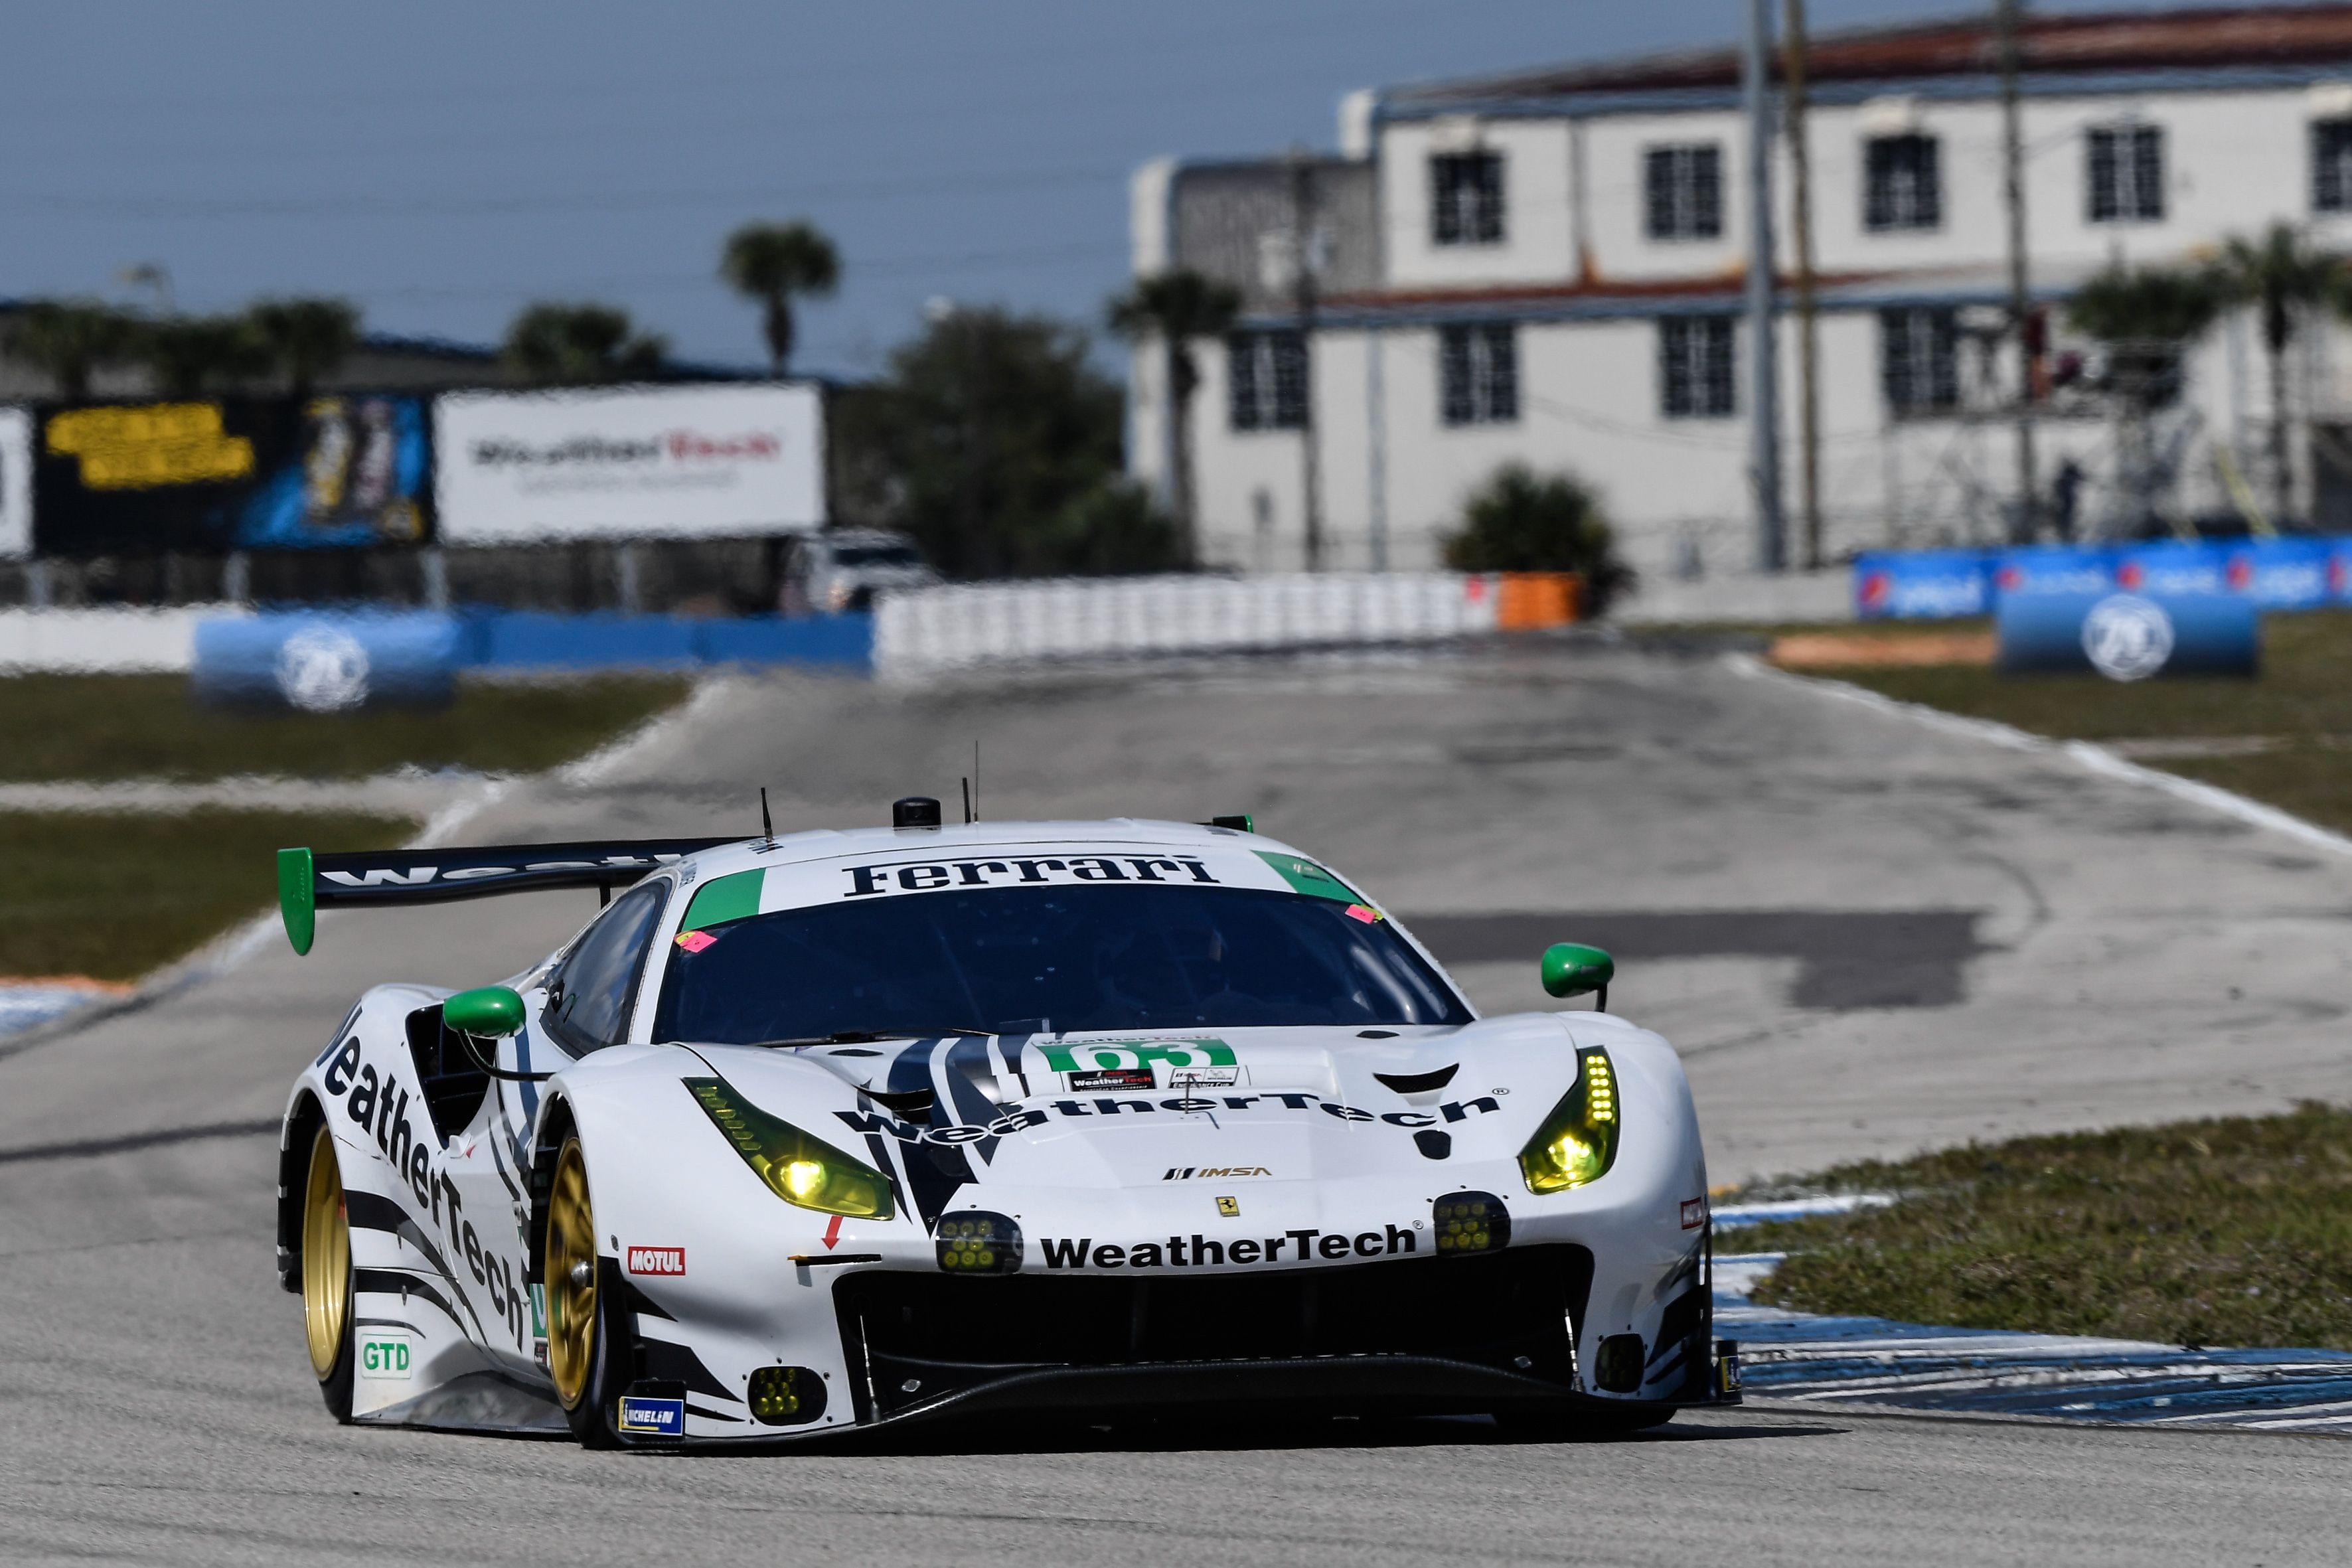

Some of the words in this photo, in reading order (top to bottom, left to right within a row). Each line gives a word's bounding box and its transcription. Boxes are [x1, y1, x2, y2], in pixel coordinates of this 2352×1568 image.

[842, 854, 1221, 898] Ferrari
[1068, 1040, 1213, 1071] 63
[1073, 1075, 1152, 1087] WeatherTech
[832, 1092, 1501, 1144] WeatherTech
[1198, 1166, 1273, 1178] IMSA
[631, 1250, 683, 1272] MOTUL
[1040, 1224, 1417, 1269] WeatherTech
[363, 1342, 410, 1370] GTD
